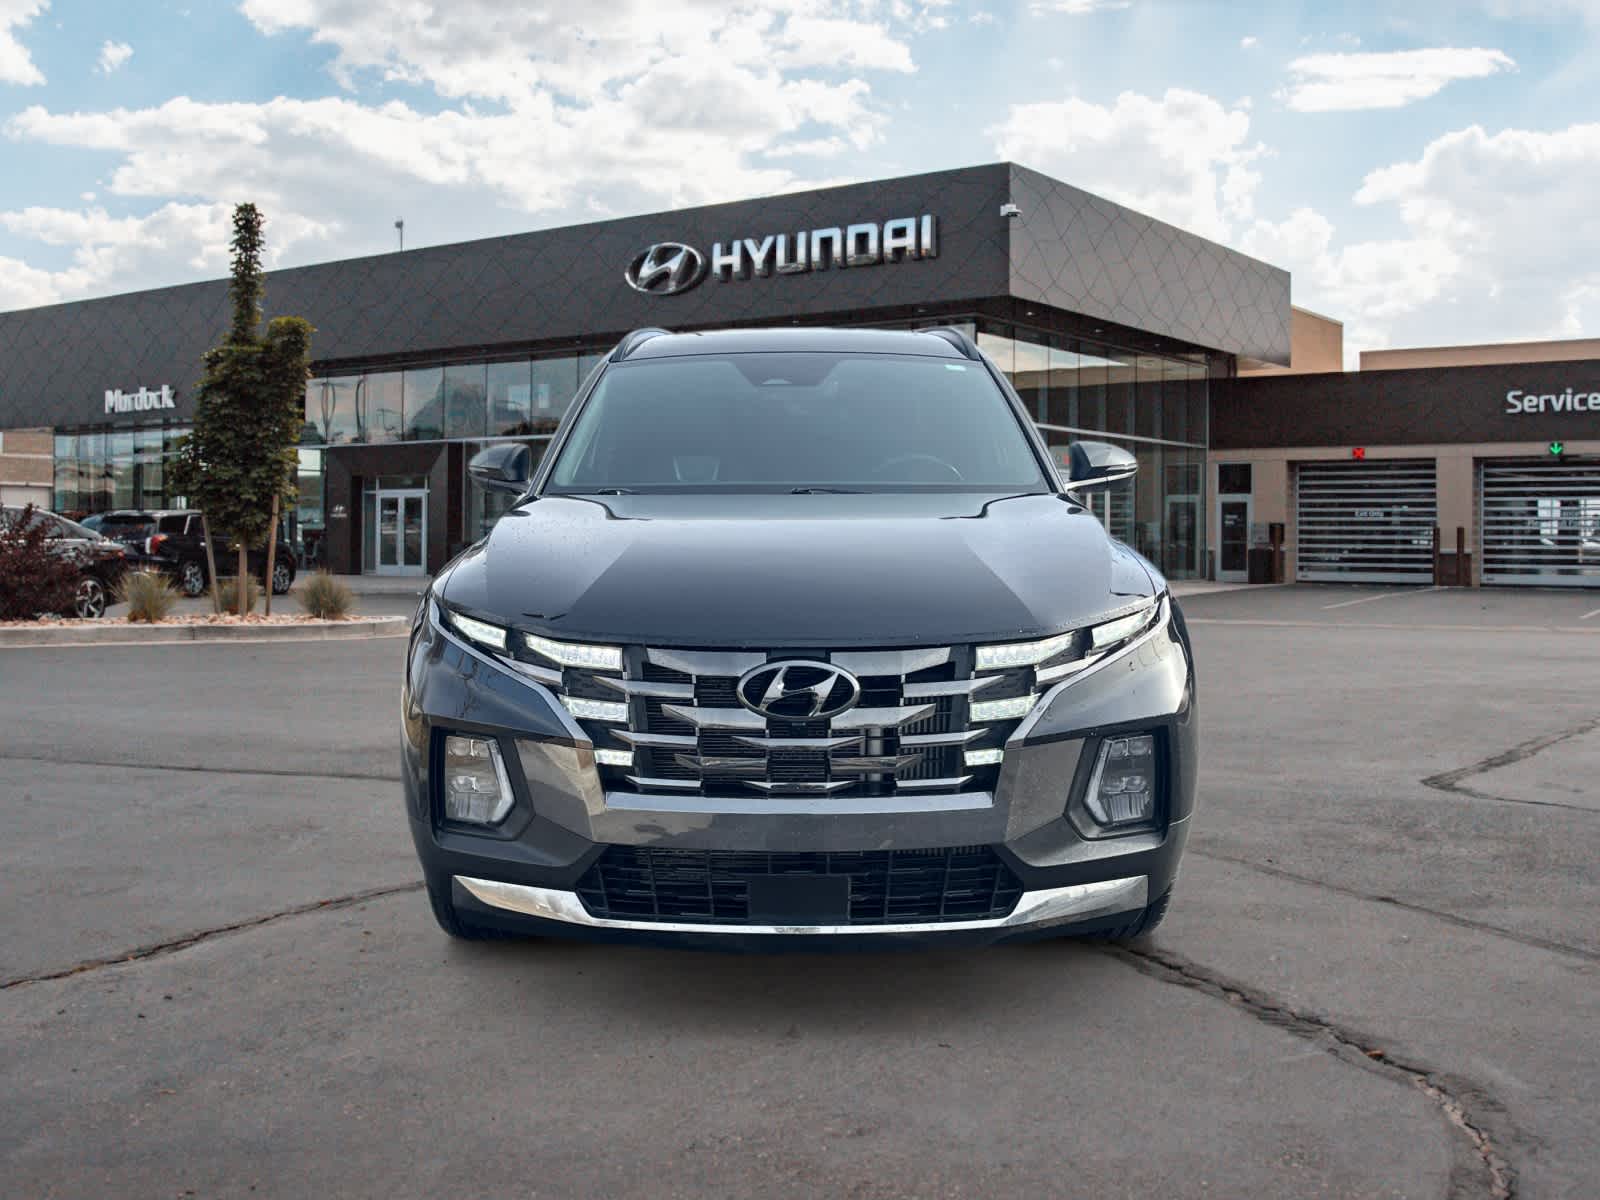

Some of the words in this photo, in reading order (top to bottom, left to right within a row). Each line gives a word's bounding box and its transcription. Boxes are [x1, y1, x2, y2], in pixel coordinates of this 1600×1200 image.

[711, 214, 936, 281] HYUNDAI
[104, 384, 176, 414] Murdock
[1505, 387, 1600, 414] Service
